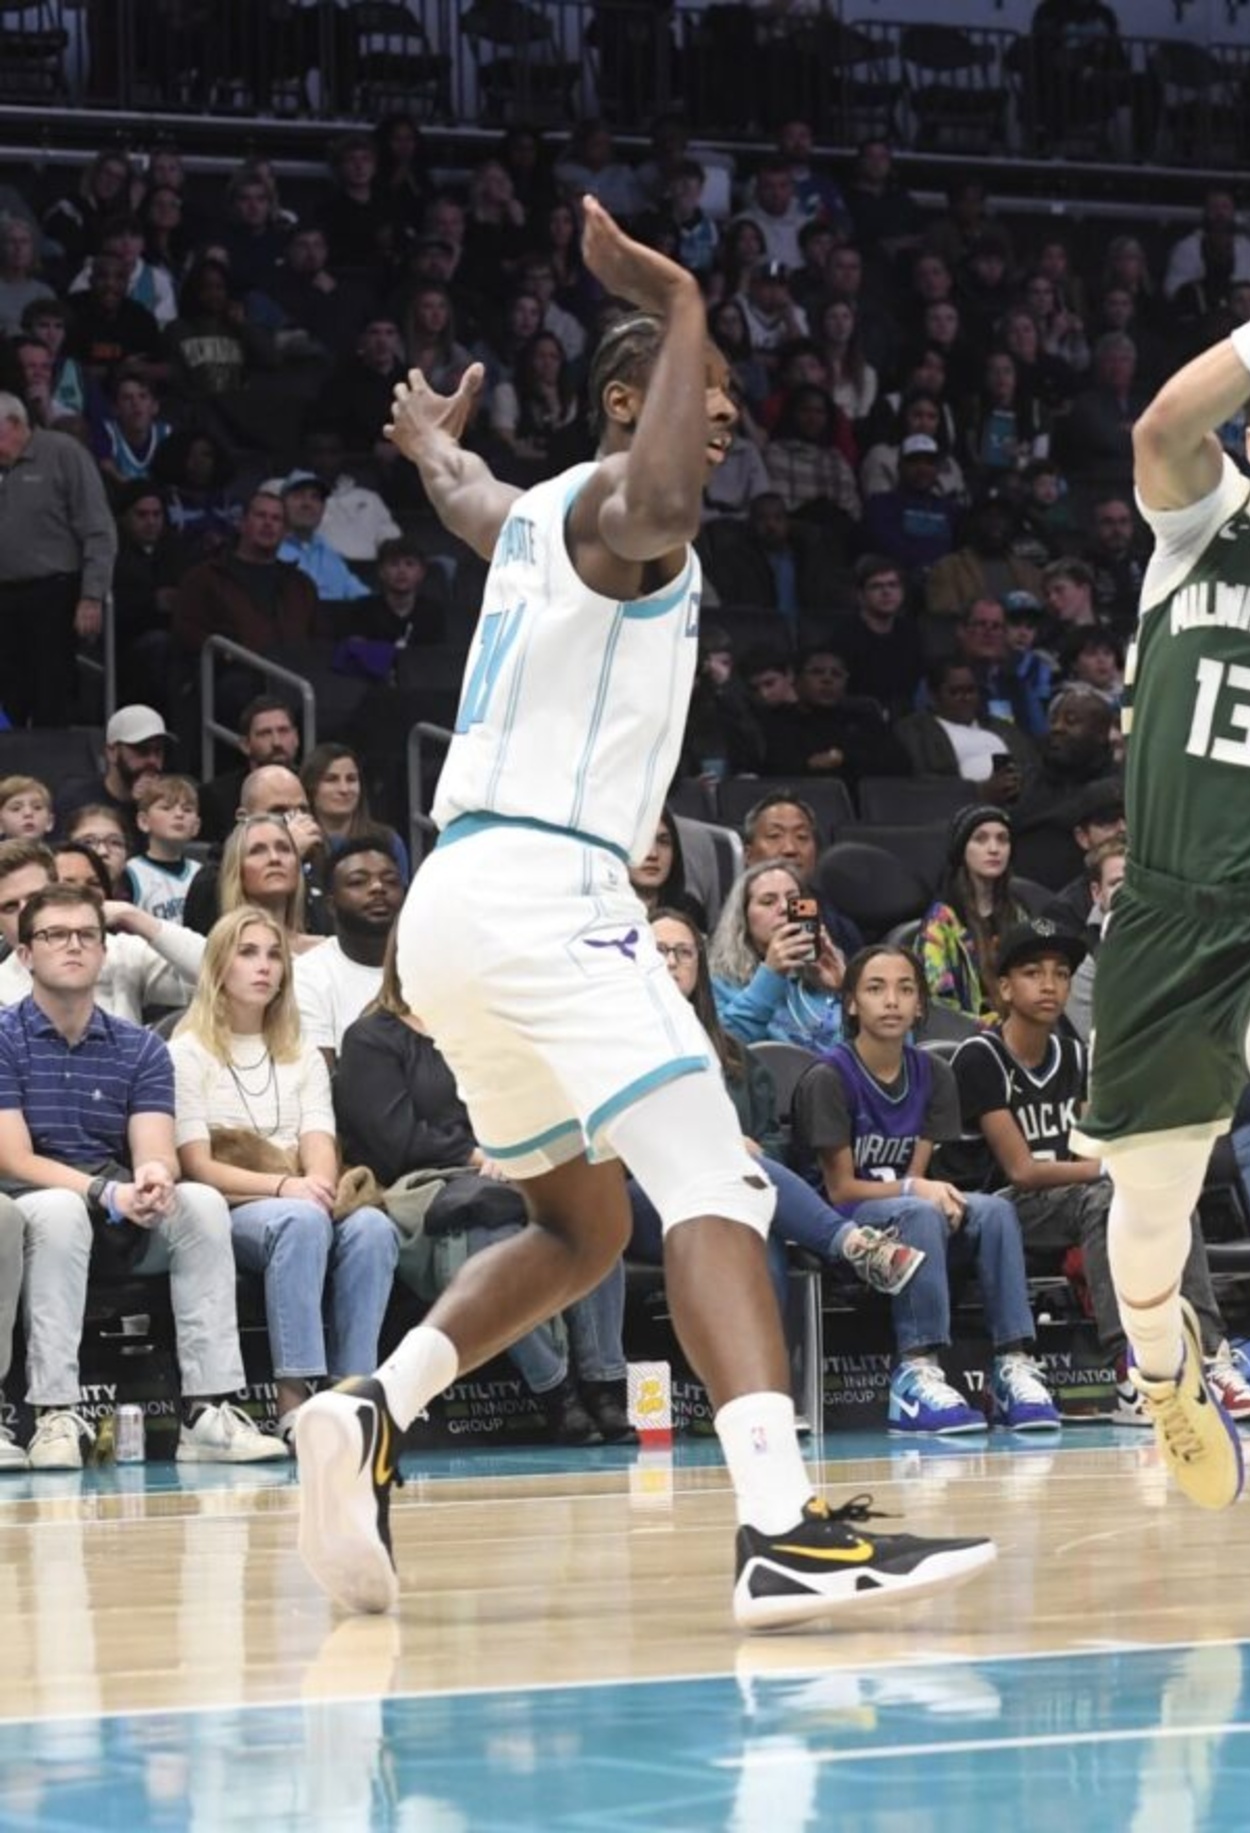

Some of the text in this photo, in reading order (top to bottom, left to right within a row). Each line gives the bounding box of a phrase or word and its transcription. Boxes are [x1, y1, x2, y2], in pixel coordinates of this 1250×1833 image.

[1017, 1098, 1077, 1141] UCK
[964, 1370, 984, 1391] 17
[448, 1420, 504, 1434] GROUP
